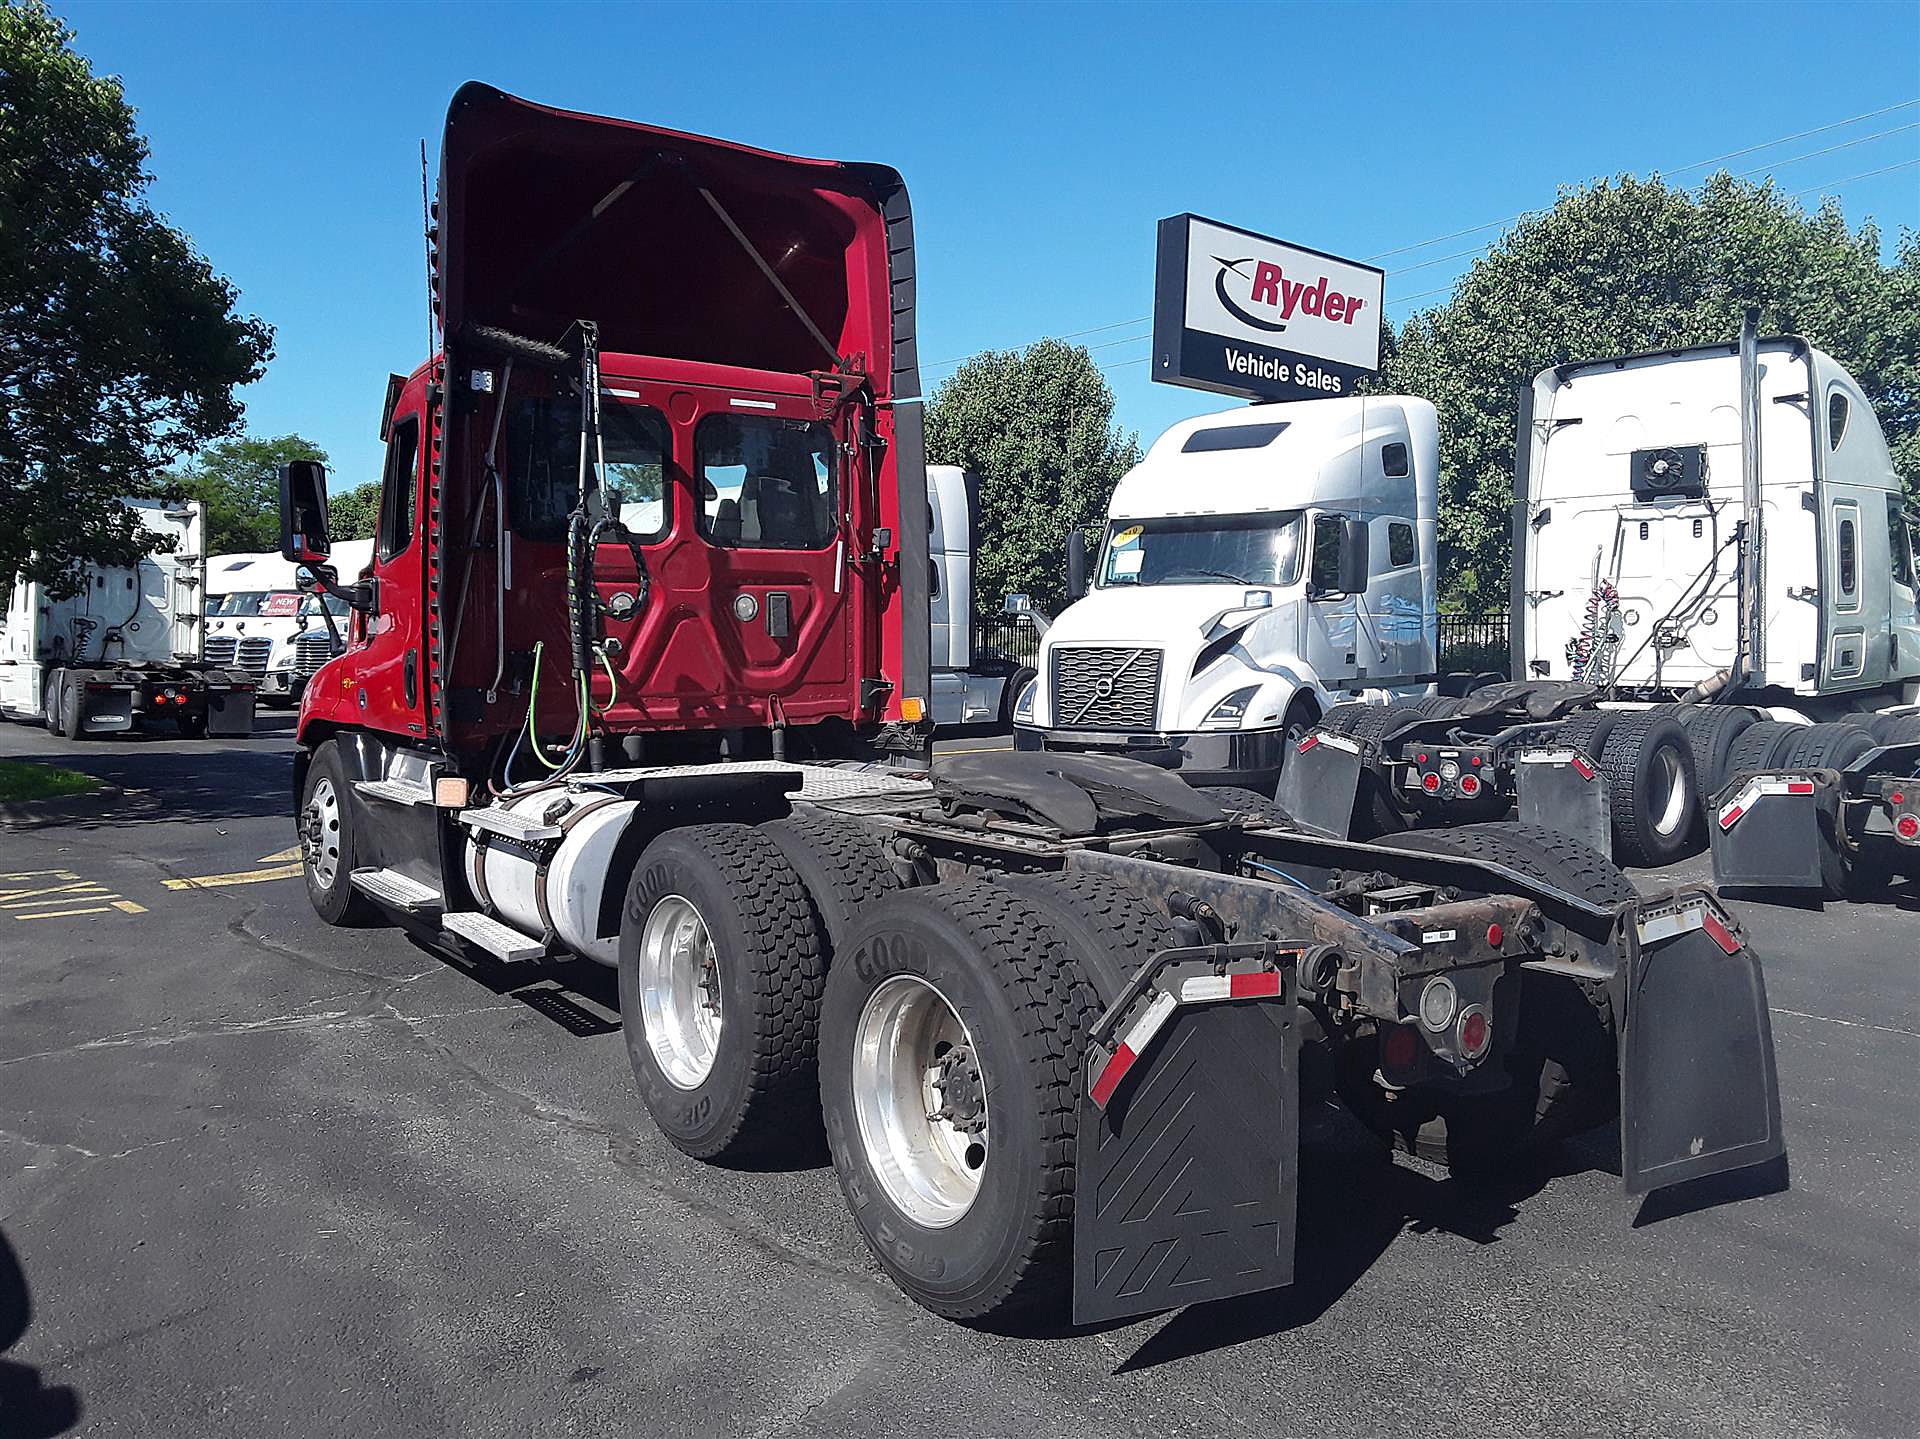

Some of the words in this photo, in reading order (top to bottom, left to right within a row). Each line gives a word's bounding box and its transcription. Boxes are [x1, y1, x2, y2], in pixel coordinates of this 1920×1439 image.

[1251, 260, 1364, 325] Ryder
[1225, 348, 1290, 382] Vehicle
[1295, 363, 1342, 393] Sales
[275, 598, 296, 606] NEW
